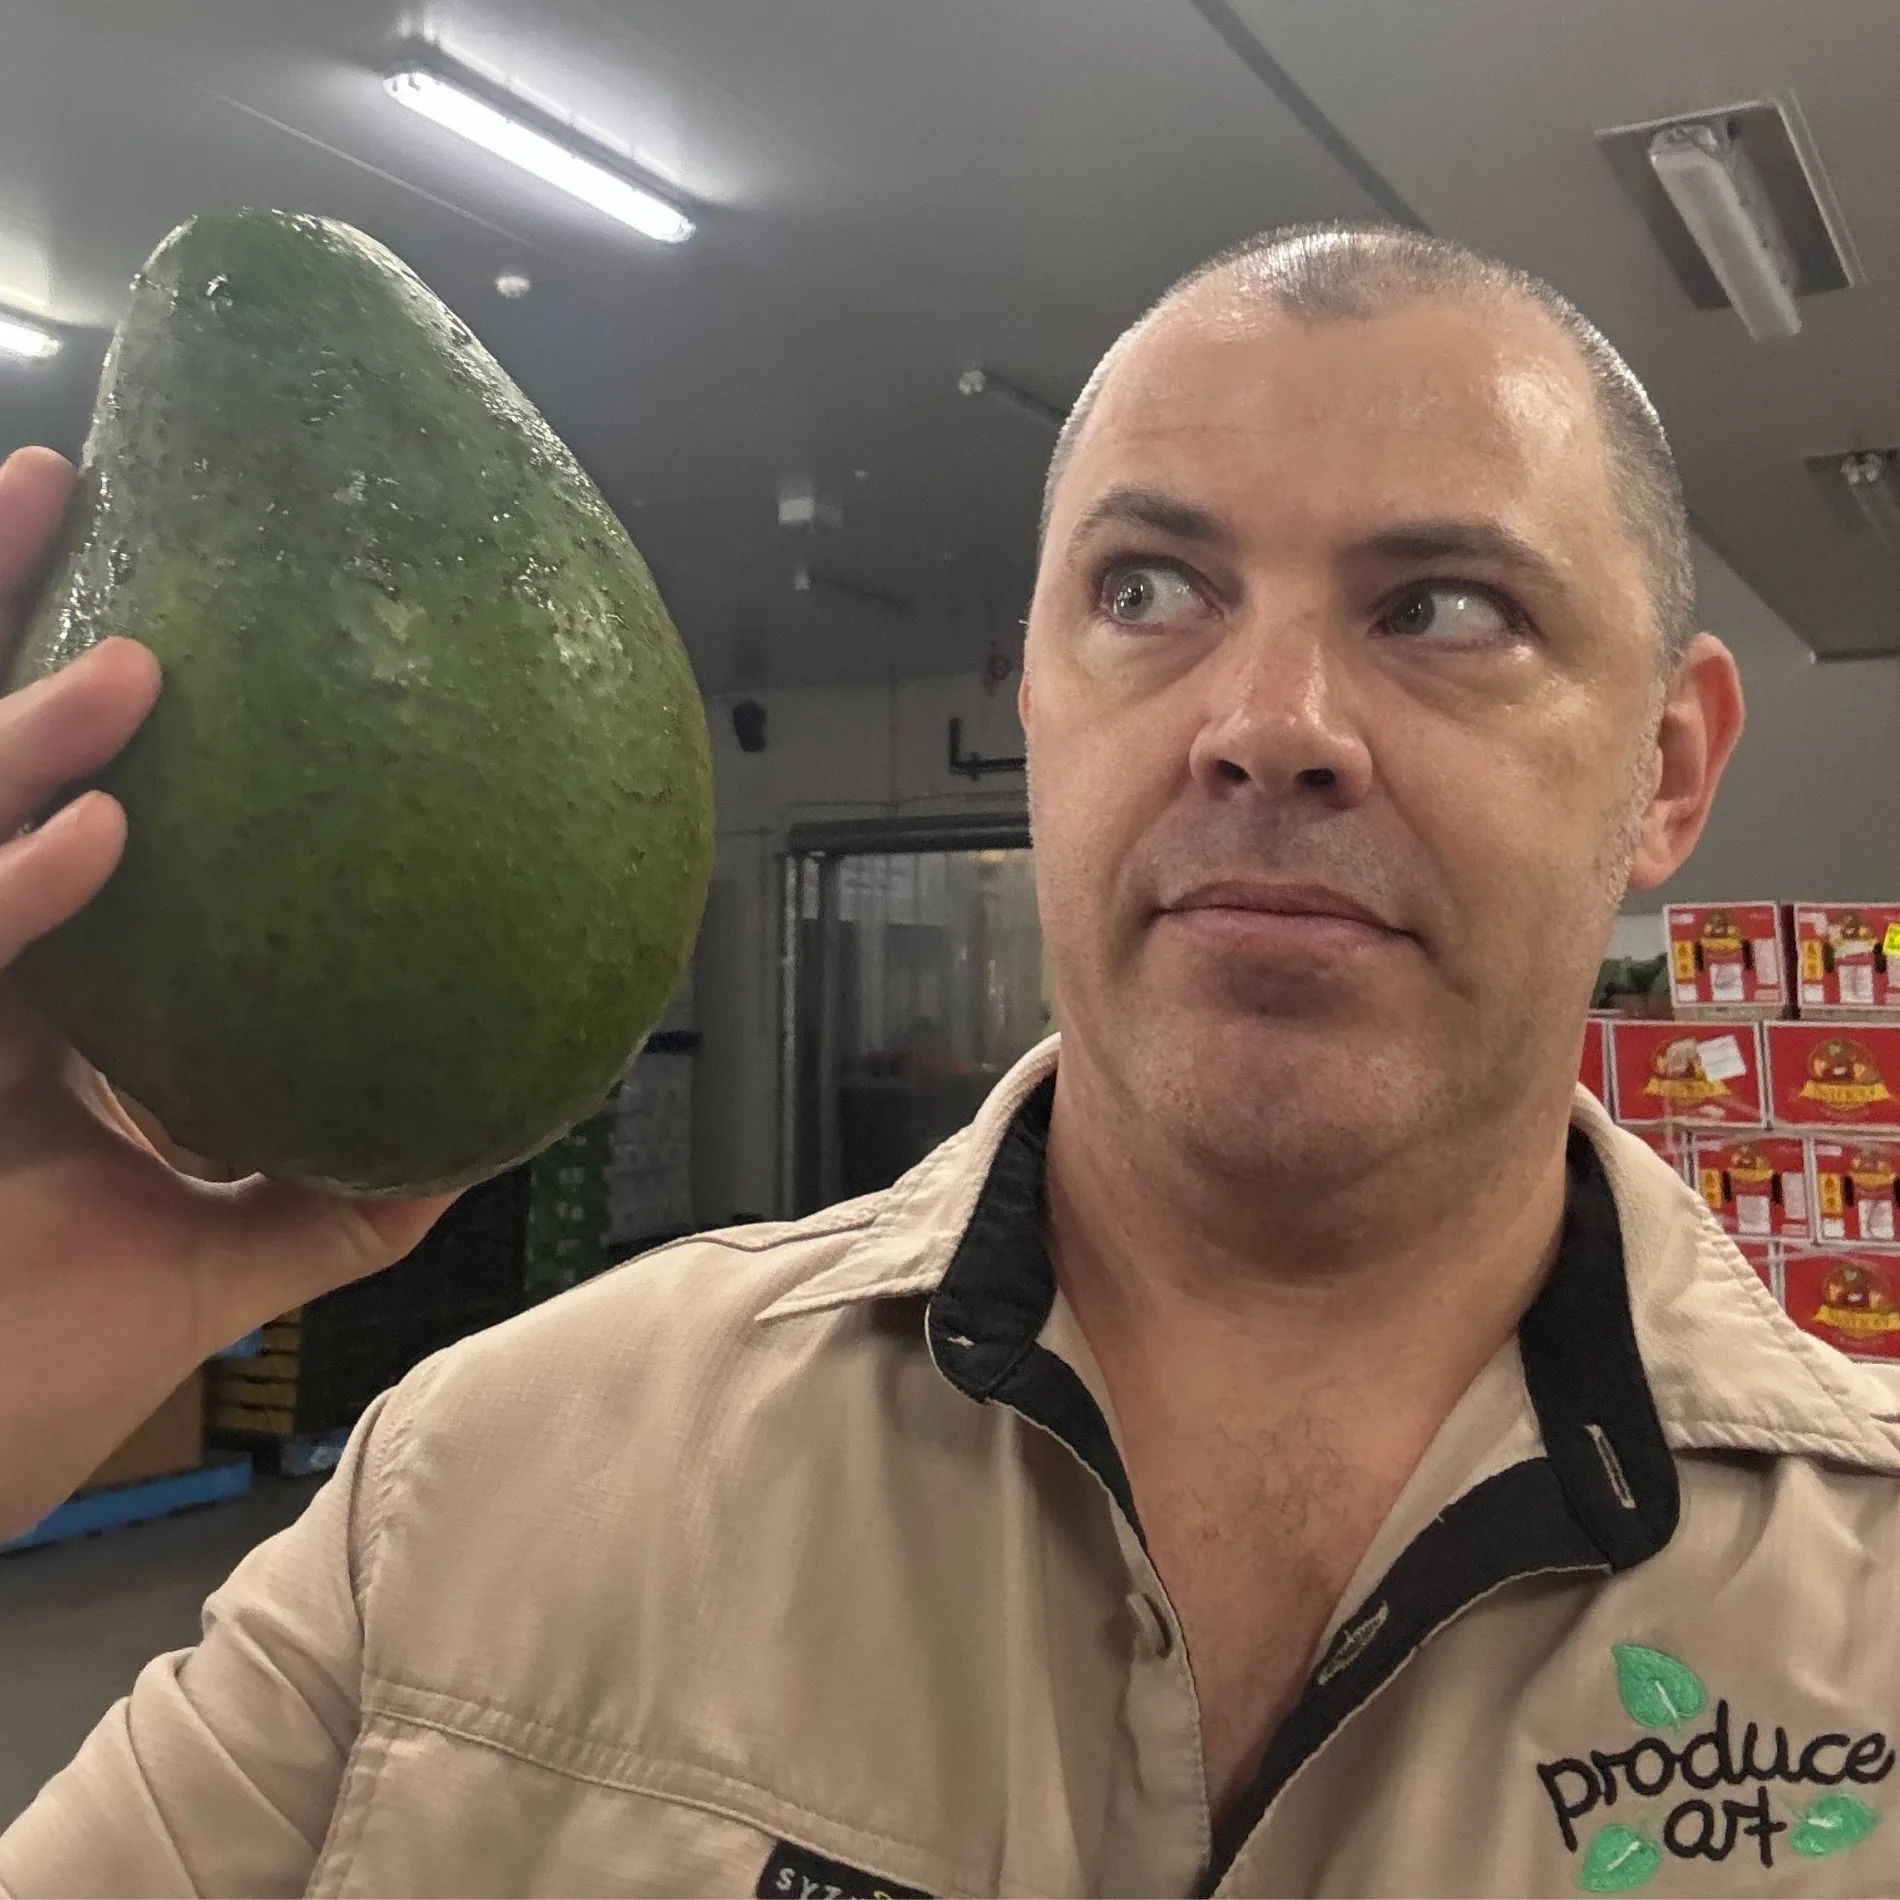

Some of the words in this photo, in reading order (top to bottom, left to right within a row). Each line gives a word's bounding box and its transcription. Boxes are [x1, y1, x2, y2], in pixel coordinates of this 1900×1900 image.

[1537, 1700, 1895, 1852] produce
[1663, 1786, 1787, 1868] art
[776, 1867, 865, 1900] SYZ
